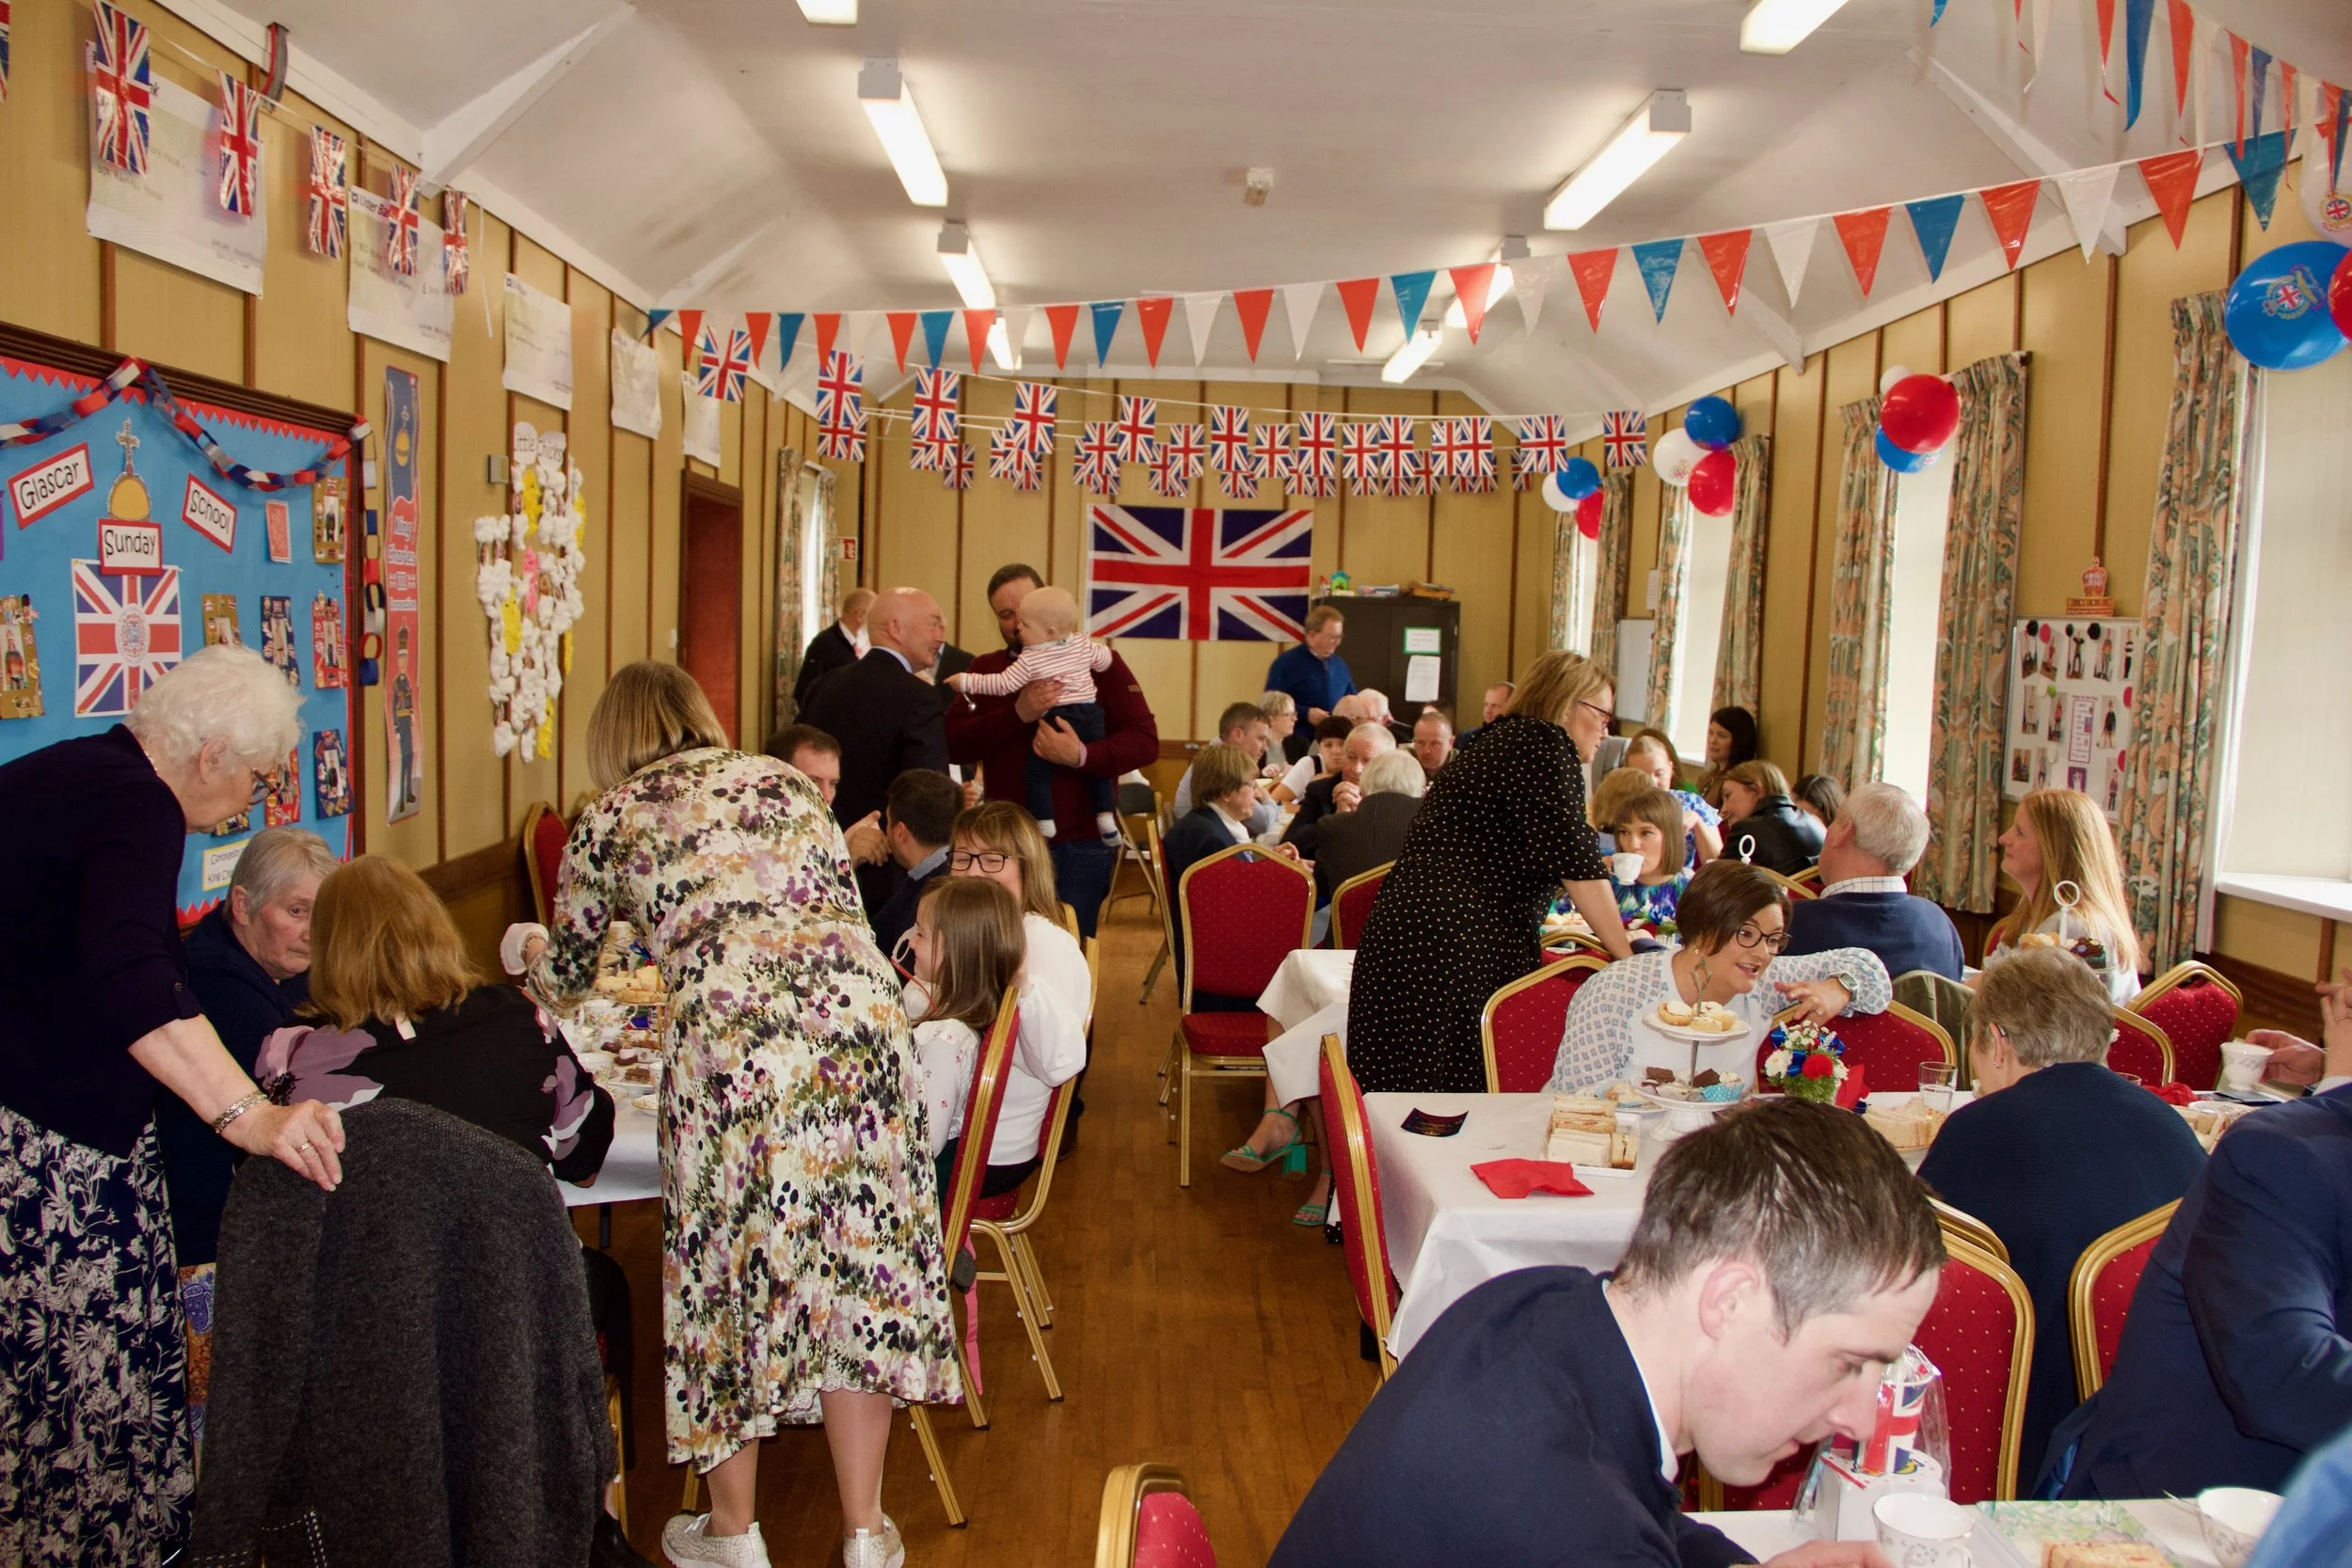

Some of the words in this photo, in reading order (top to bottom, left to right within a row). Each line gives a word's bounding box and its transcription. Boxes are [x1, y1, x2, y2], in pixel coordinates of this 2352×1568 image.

[20, 462, 79, 510] Glascar
[190, 489, 231, 535] School
[103, 529, 156, 558] Sunday
